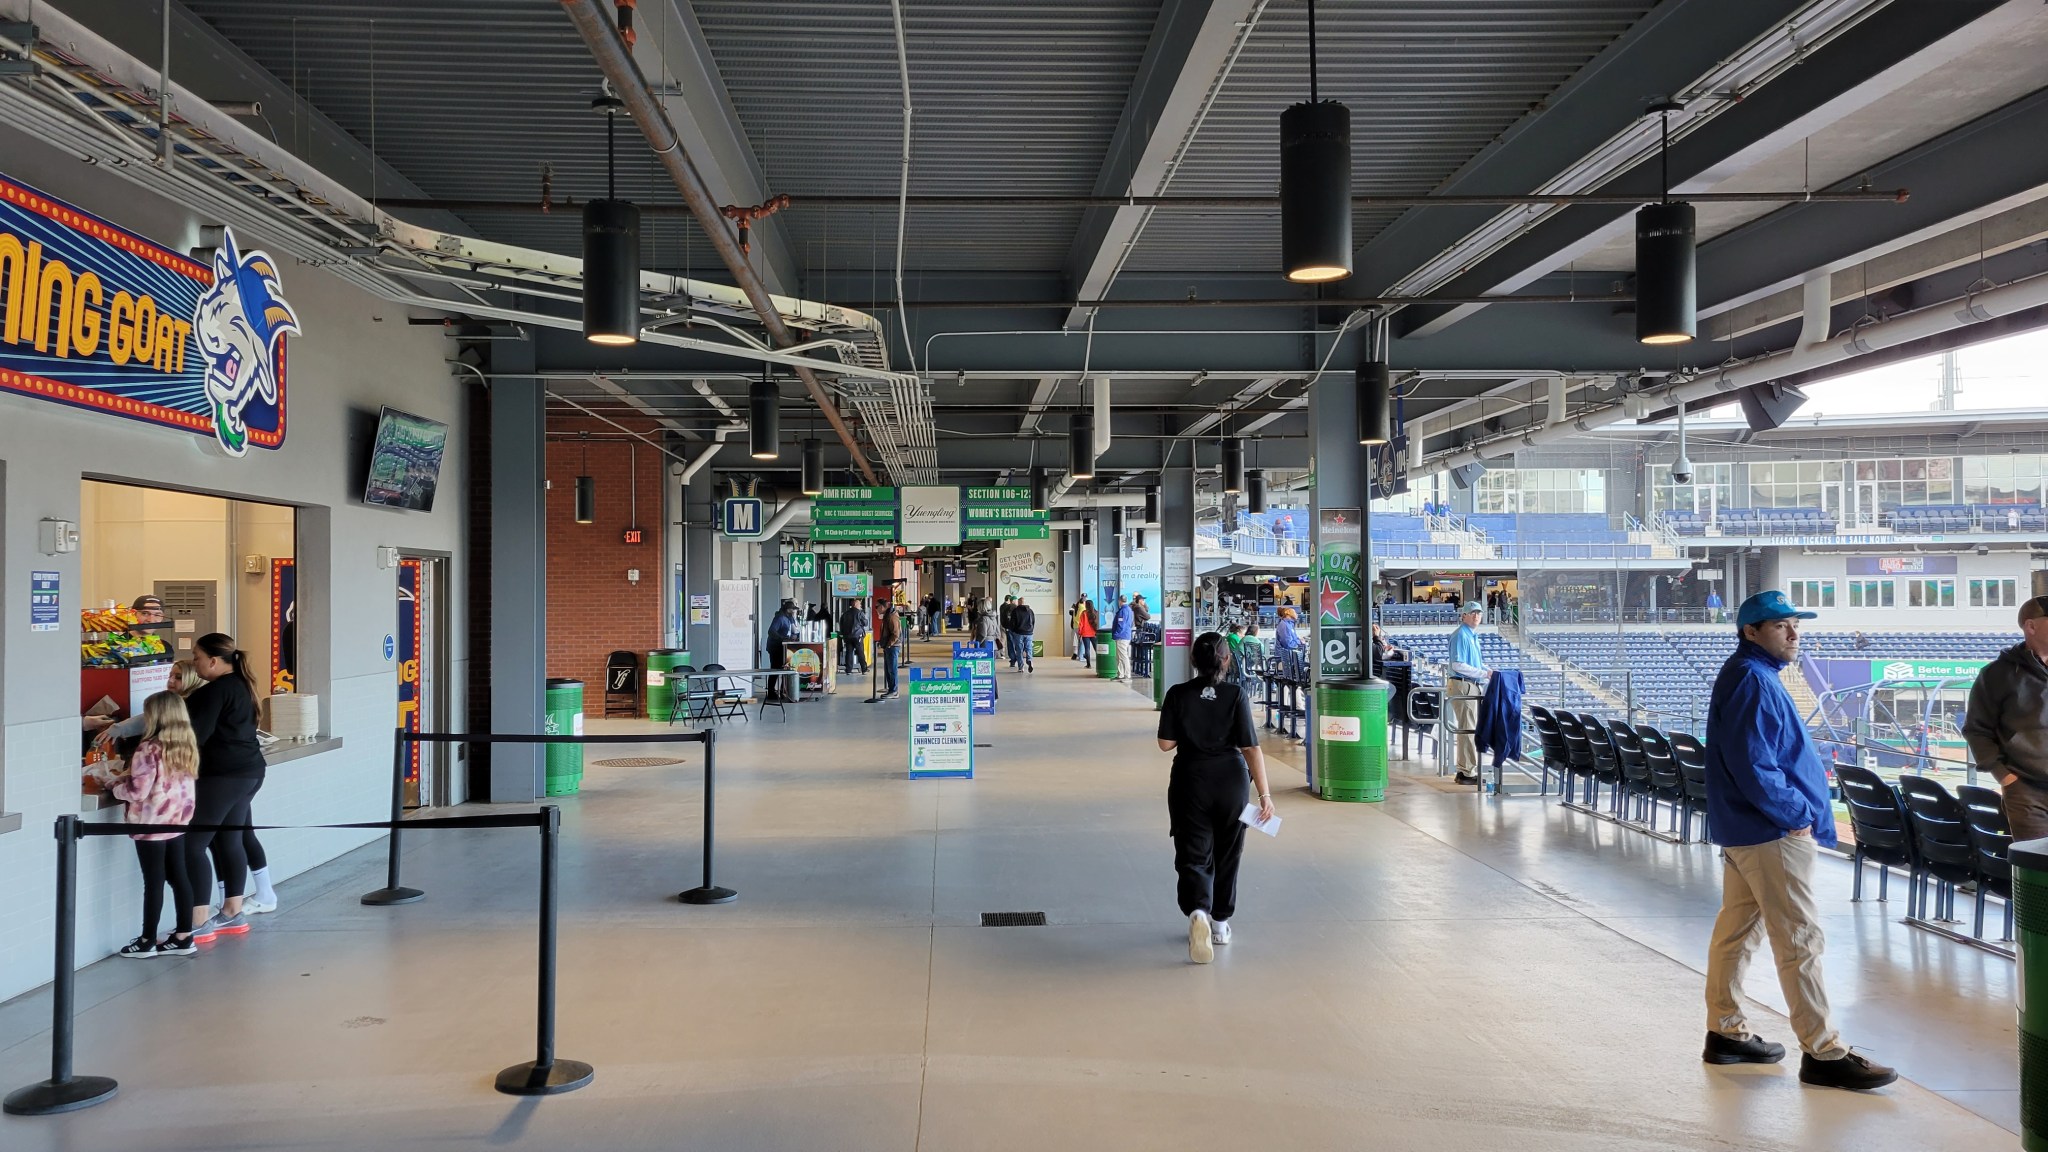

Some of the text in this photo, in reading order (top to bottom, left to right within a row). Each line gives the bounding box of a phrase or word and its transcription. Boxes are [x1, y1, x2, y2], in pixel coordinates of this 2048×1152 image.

[109, 290, 190, 374] GOAT
[823, 488, 872, 499] AMR FIRST AID
[968, 488, 1000, 499] SECTION
[904, 504, 957, 519] Yuengling
[968, 508, 1034, 518] WOMEN'S RESTROOM
[733, 503, 754, 530] M
[968, 528, 1019, 537] HOME PLATE CLUB
[1322, 526, 1358, 534] Heineken
[626, 530, 641, 543] EXIT
[1803, 536, 1832, 544] TICKETS
[1849, 535, 1866, 543] SALE
[1012, 552, 1031, 560] YOUR
[1000, 557, 1032, 569] SOUVENIR
[1010, 563, 1033, 572] PENNY
[1137, 571, 1159, 580] reality
[1918, 666, 1951, 674] Better
[913, 696, 966, 704] CASHLESS BALLPARK
[941, 737, 967, 745] CLEANING
